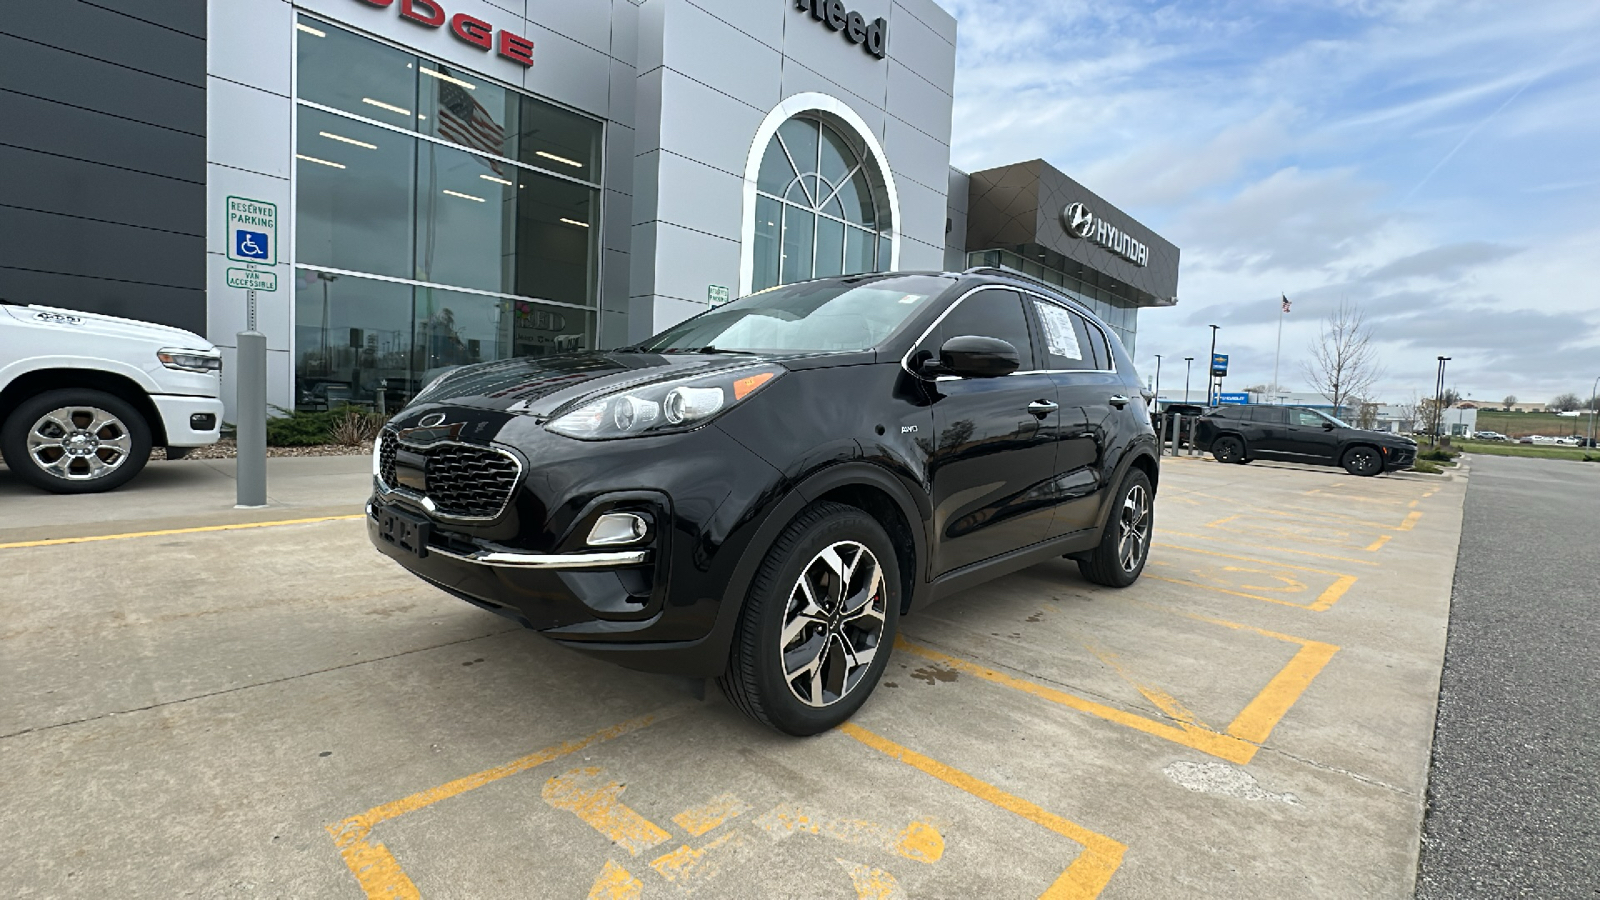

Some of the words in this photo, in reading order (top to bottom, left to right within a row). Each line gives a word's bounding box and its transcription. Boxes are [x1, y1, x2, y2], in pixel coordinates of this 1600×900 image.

[349, 0, 534, 67] DGE
[231, 201, 274, 217] RESERVED
[231, 213, 274, 228] PARKING
[1096, 218, 1149, 267] HYUNDAI
[230, 278, 274, 289] ACCESSIBLE
[245, 272, 260, 280] VAN
